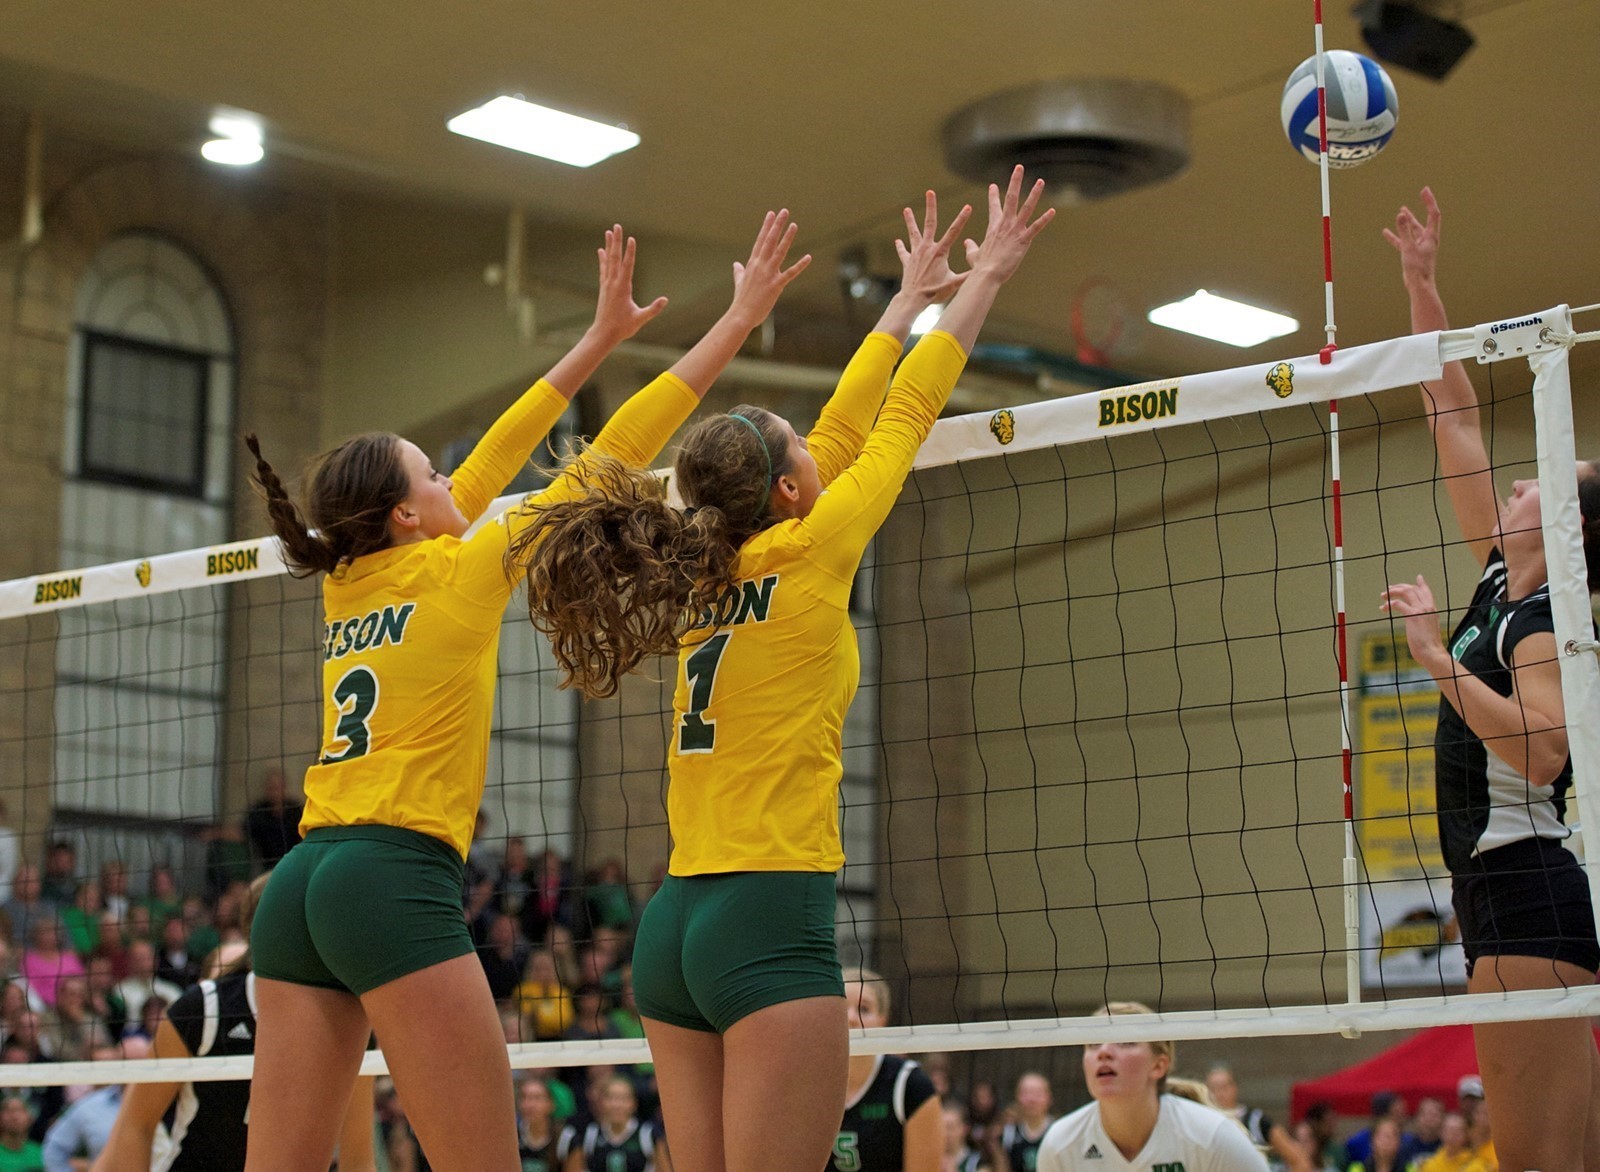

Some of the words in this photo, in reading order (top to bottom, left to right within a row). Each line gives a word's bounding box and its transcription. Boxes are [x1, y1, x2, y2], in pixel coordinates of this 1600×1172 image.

[1499, 317, 1543, 332] Senoh
[1098, 387, 1178, 427] BISON
[206, 547, 259, 577] BISON
[34, 576, 82, 604] BISON
[677, 629, 734, 755] 1
[319, 664, 380, 766] 3
